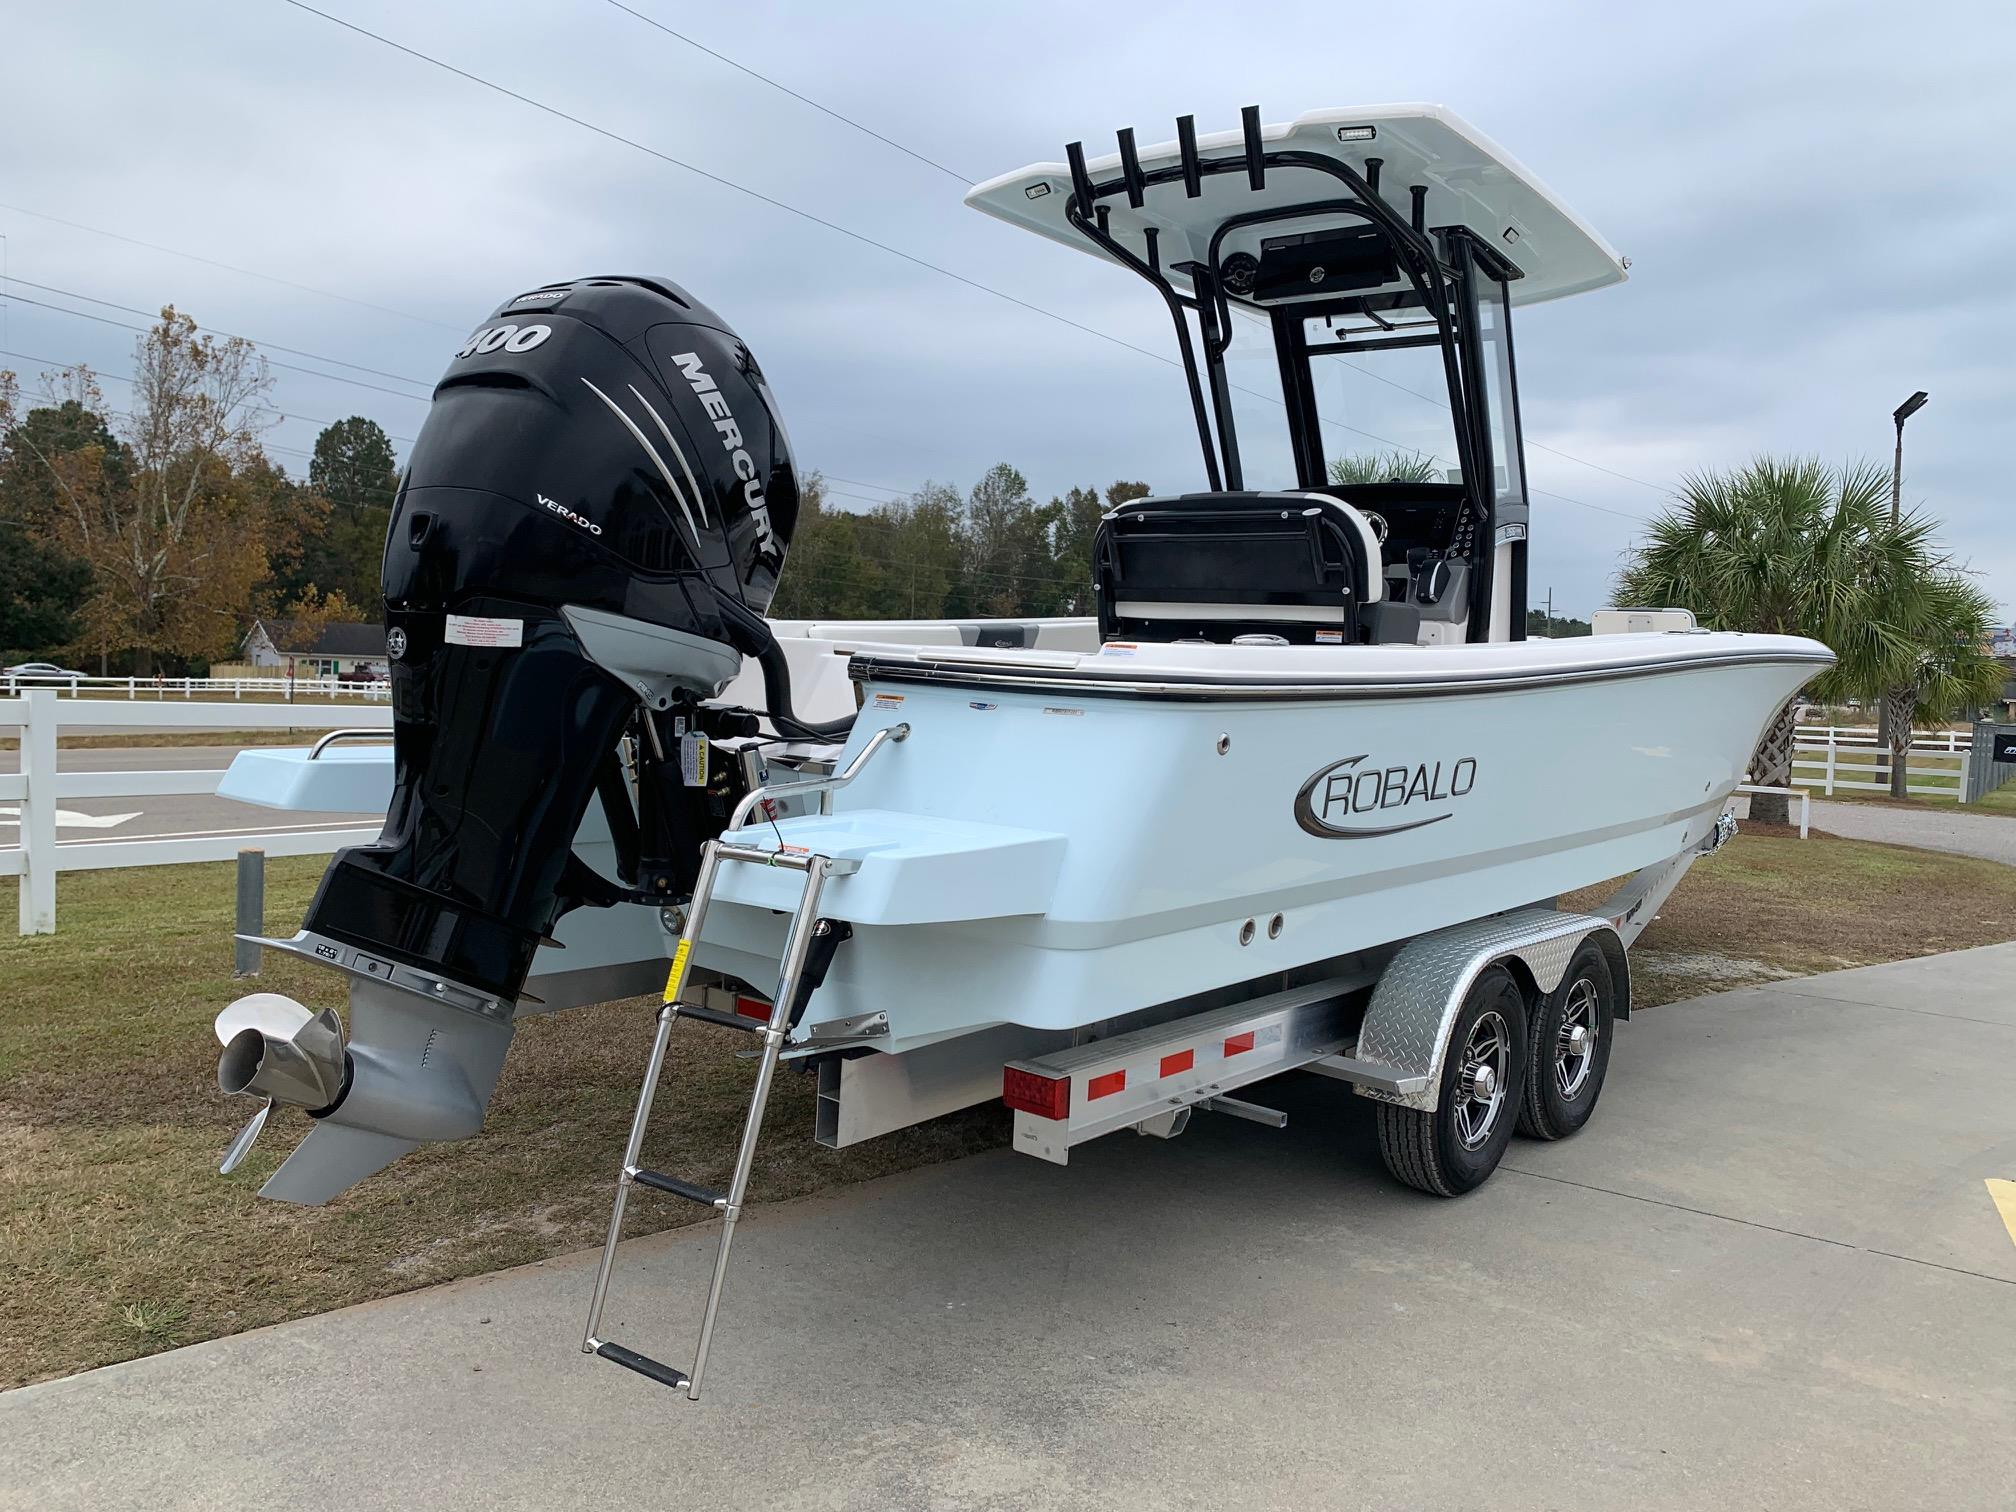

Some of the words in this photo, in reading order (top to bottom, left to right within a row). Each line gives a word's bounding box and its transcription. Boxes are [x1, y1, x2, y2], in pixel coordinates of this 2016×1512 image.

[670, 351, 778, 557] MERCURY
[536, 493, 602, 535] VERADO
[1322, 756, 1477, 819] ROBALO
